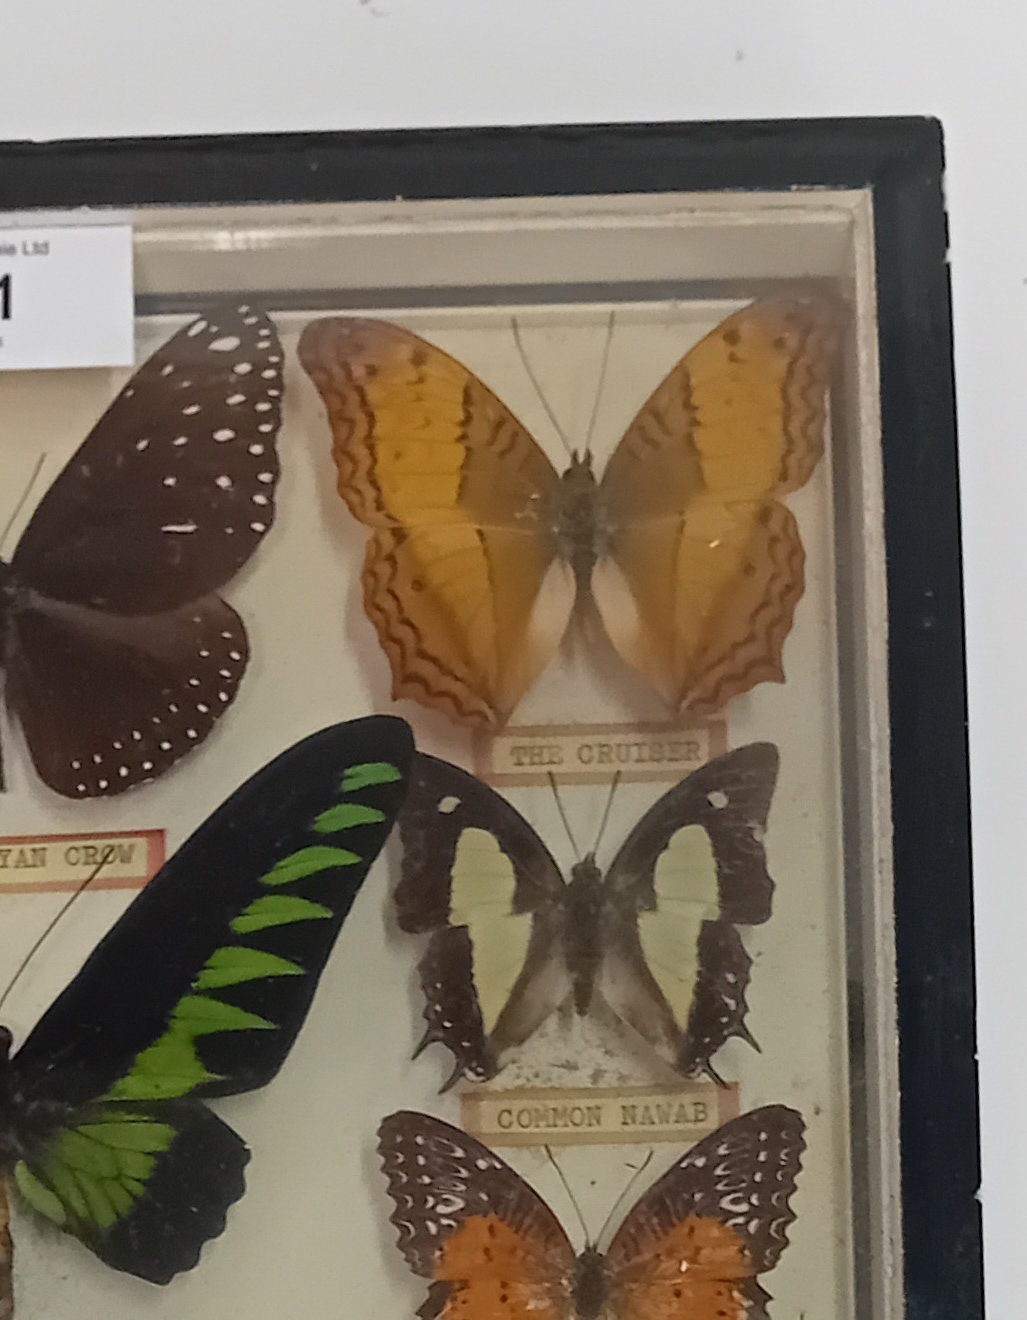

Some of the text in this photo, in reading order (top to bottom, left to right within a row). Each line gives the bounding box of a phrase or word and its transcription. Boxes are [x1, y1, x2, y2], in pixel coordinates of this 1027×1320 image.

[23, 240, 49, 256] Ltd
[509, 741, 700, 766] THE CRUISER
[64, 843, 137, 867] CROW
[497, 1102, 709, 1130] COMMON NAWAB
